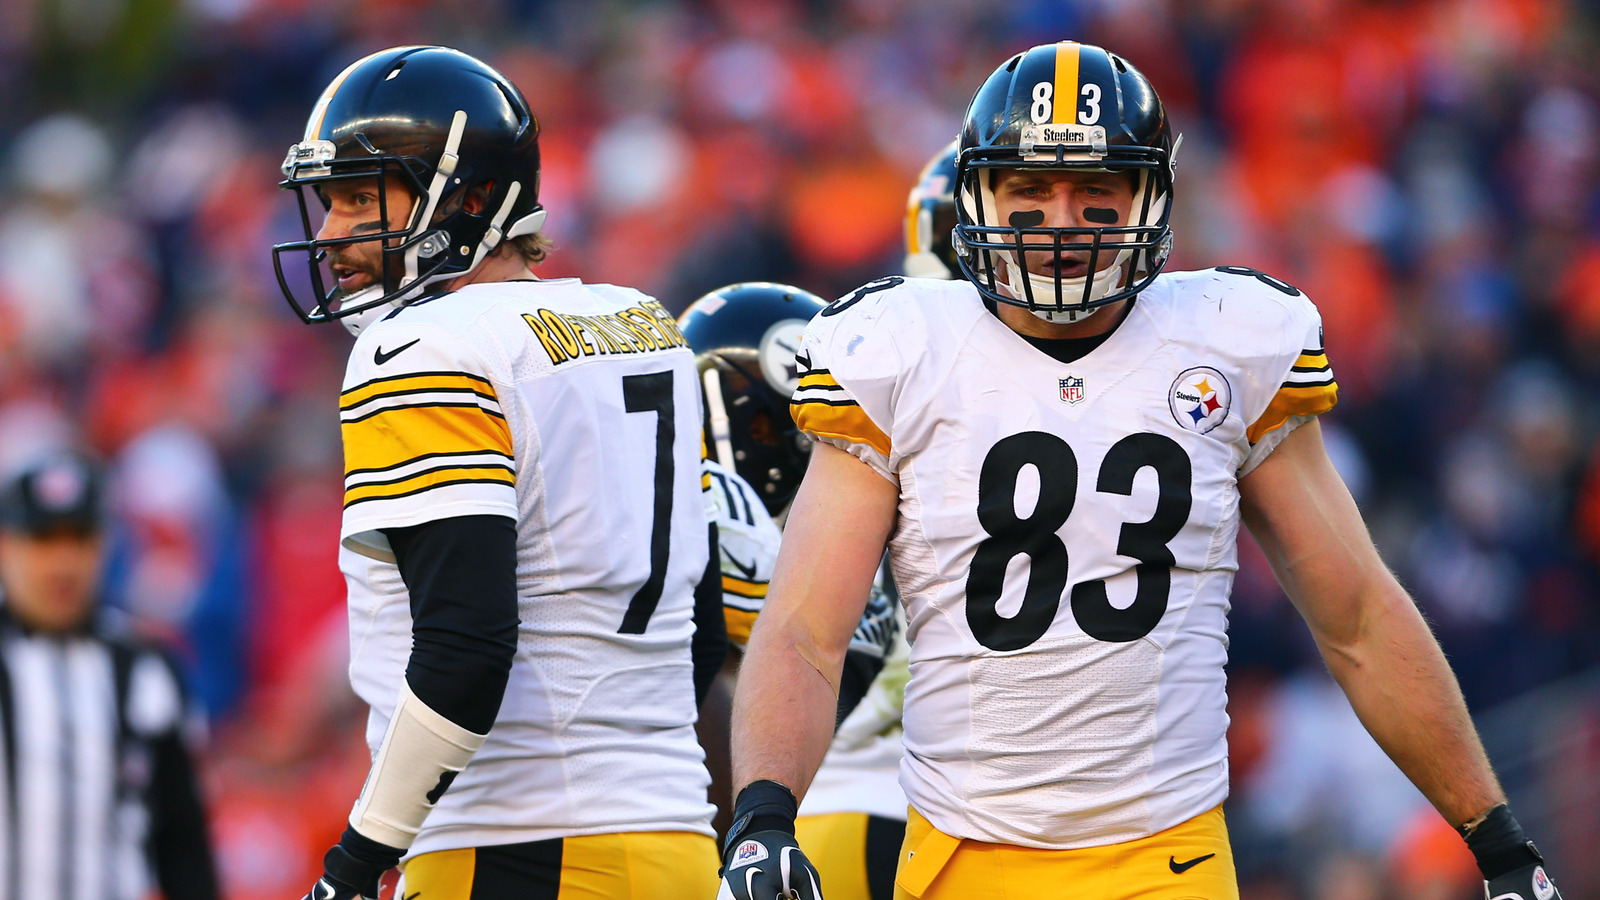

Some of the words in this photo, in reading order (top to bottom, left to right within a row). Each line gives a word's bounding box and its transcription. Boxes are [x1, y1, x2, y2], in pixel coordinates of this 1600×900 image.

[1044, 128, 1084, 142] Steelers
[1062, 388, 1082, 400] NFL
[1176, 391, 1201, 403] Steelers
[617, 370, 675, 634] 7
[966, 431, 1192, 651] 83
